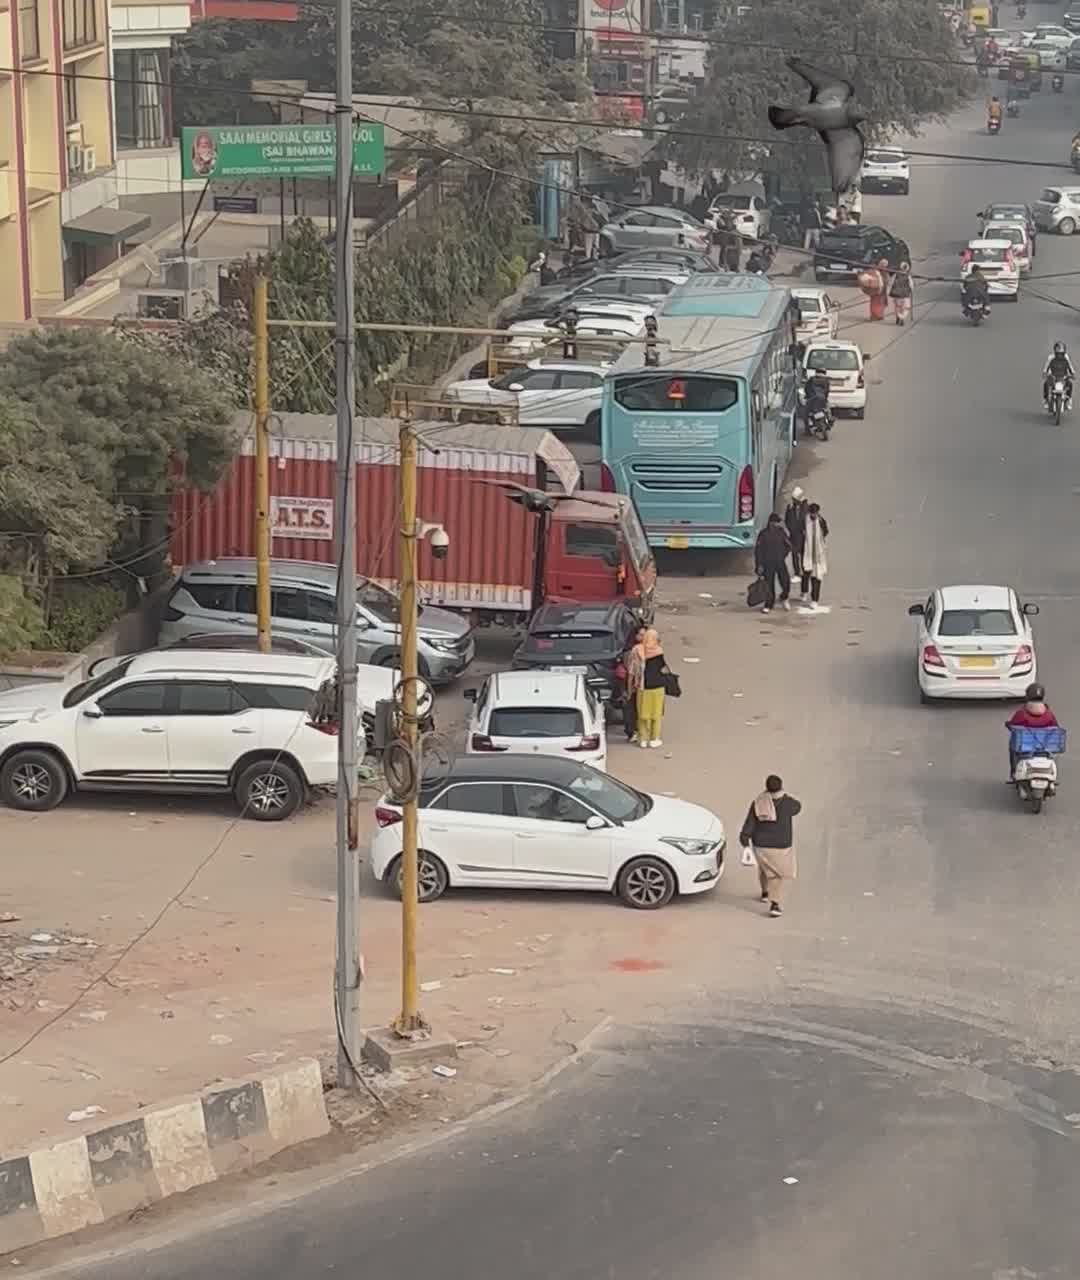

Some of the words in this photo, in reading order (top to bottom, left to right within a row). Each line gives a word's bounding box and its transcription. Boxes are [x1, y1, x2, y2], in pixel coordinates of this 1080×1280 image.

[246, 130, 301, 144] MEMORIAL
[303, 129, 331, 143] GIRLS
[273, 507, 330, 528] A.T.S.
